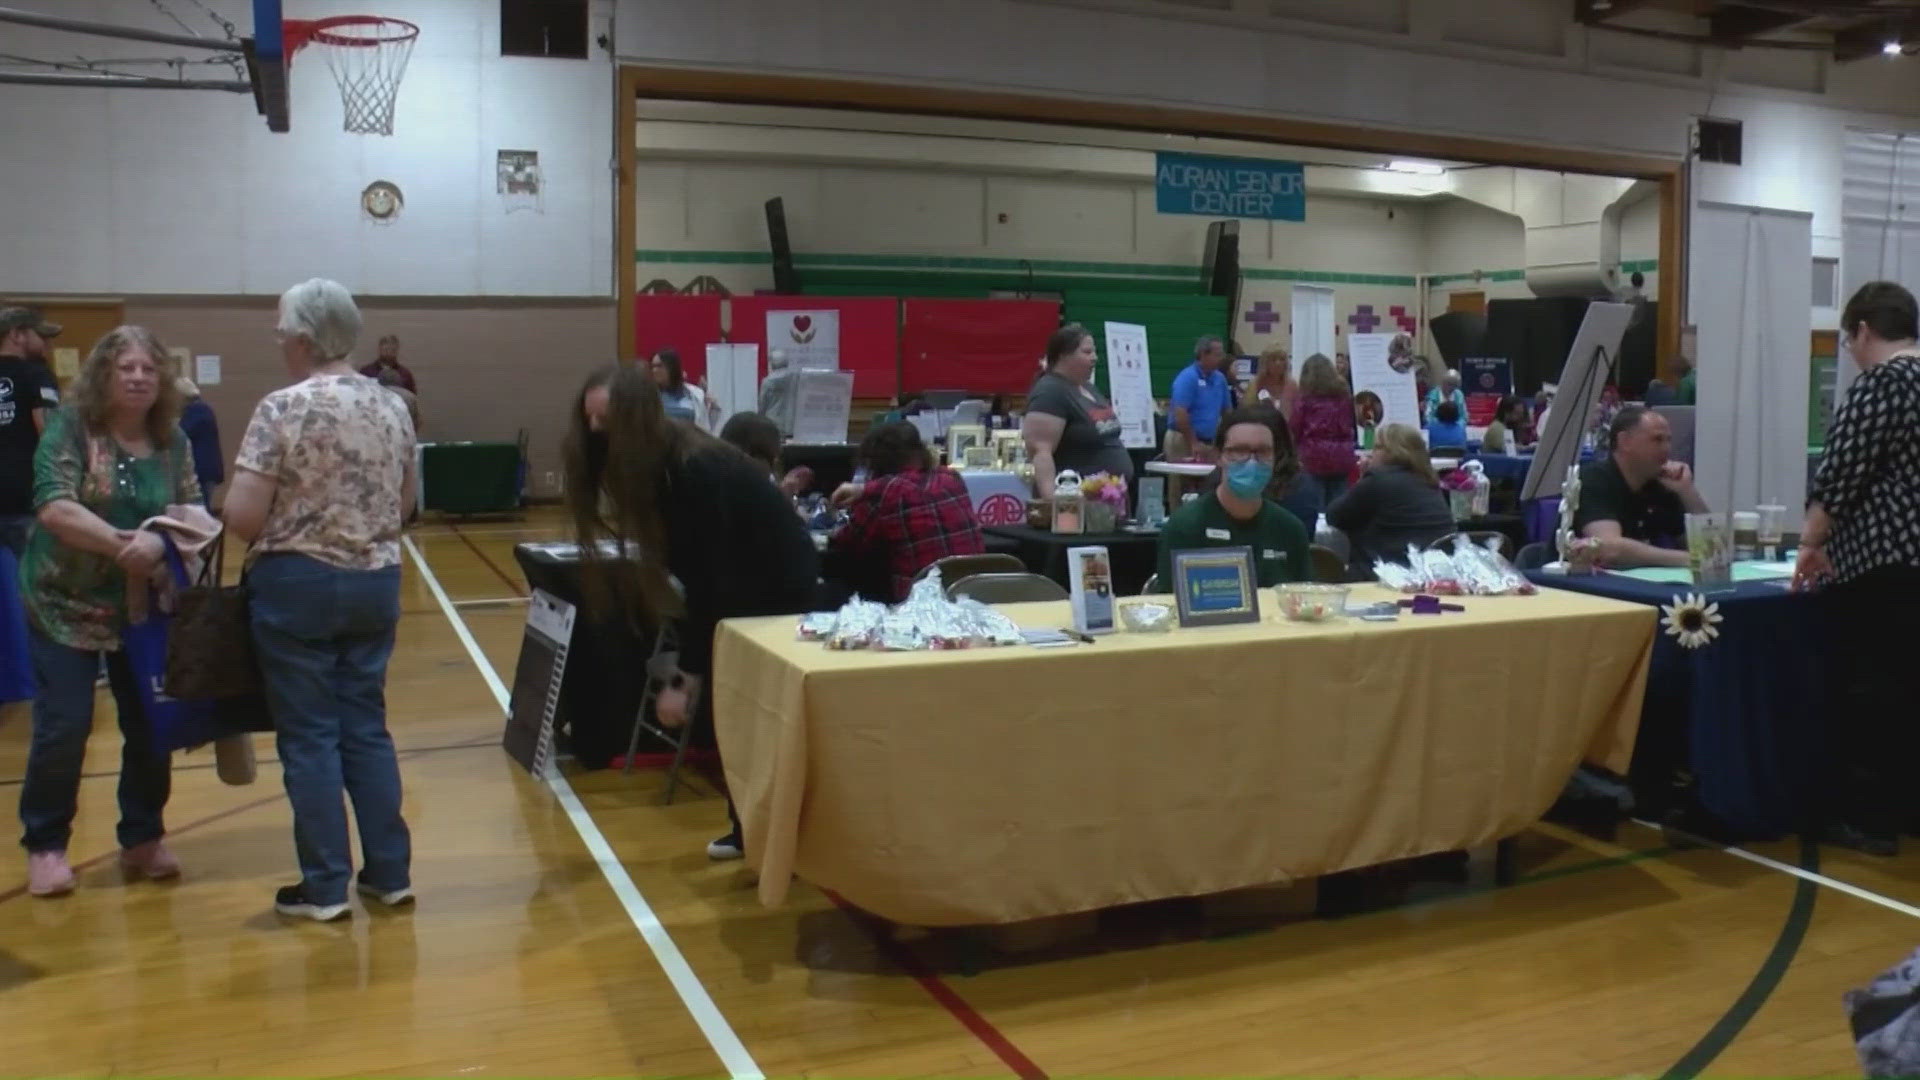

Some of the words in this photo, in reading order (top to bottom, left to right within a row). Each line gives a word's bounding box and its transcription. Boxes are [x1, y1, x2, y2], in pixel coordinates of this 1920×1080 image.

[1159, 164, 1229, 190] ADRIAN
[1236, 170, 1303, 194] SENIOR
[1191, 190, 1274, 215] CENTER
